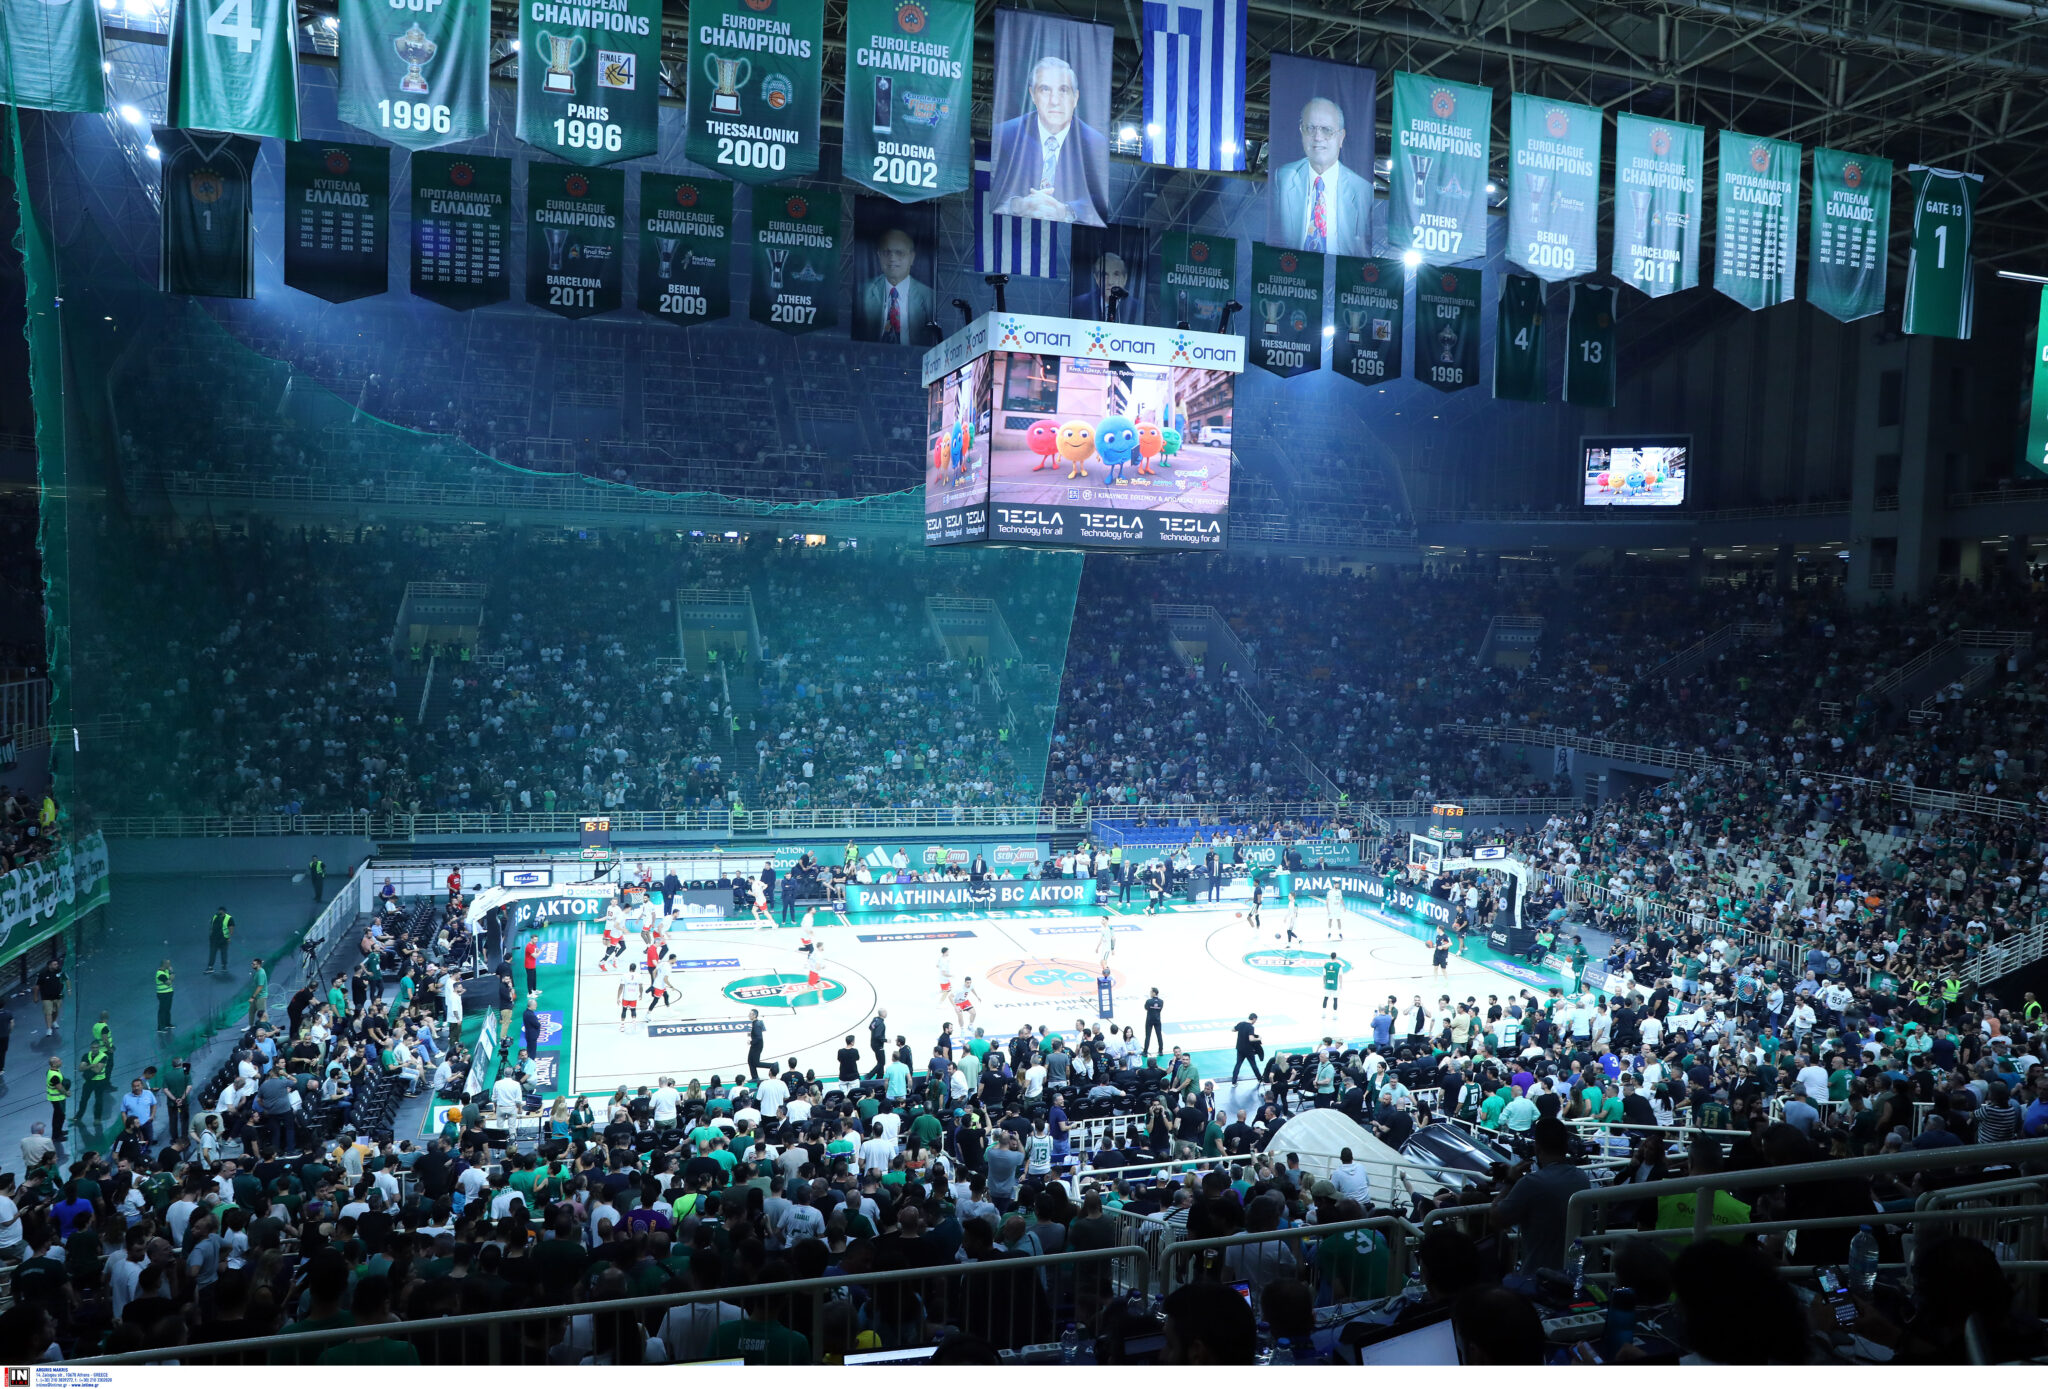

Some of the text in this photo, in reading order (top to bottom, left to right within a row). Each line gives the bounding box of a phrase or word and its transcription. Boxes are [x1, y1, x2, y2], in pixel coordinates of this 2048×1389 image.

[206, 0, 261, 53] 4
[531, 2, 650, 36] CHAMPIONS
[722, 13, 791, 36] EUROPEAN
[700, 25, 811, 58] CHAMPIONS
[871, 35, 949, 59] EUROLEAGUE
[857, 48, 962, 79] CHAMPIONS
[378, 99, 451, 134] 1996
[567, 103, 609, 121] PARIS
[553, 118, 622, 152] 1996
[706, 120, 799, 144] THESSALONIKI
[1411, 118, 1472, 140] EUROLEAGUE
[877, 141, 936, 161] BOLOGNA
[1400, 130, 1482, 159] CHAMPIONS
[1527, 138, 1584, 159] EUROLEAGUE
[716, 138, 786, 171] 2000
[1517, 150, 1593, 176] CHAMPIONS
[872, 156, 938, 188] 2002
[1632, 156, 1686, 176] EUROLEAGUE
[314, 179, 361, 193] ΚΥΠΕΛΛΑ
[1622, 167, 1695, 193] CHAMPIONS
[1725, 173, 1792, 194] ΠΡΩΤΑΘΛΗΜΑΤΑ
[305, 189, 369, 207] ΕΛΛΑΔΟΣ
[420, 188, 502, 204] ΠΡΩΤΑΘΛΗΜΑΤΑ
[1733, 185, 1783, 207] ΕΛΛΑΔΟΣ
[1833, 190, 1869, 207] ΚΥΠΕΛΛΑ
[430, 200, 492, 217] ΕΛΛΑΔΟΣ
[546, 199, 606, 213] EUROLEAGUE
[1826, 201, 1874, 222] ΕΛΛΑΔΟΣ
[1926, 200, 1962, 217] GATE 13
[202, 210, 212, 231] 1
[535, 209, 616, 228] CHAMPIONS
[657, 209, 715, 223] EUROLEAGUE
[1419, 213, 1458, 229] ATHENS
[647, 218, 724, 238] CHAMPIONS
[768, 221, 824, 235] EUROLEAGUE
[1537, 230, 1568, 245] BERLIN
[759, 230, 833, 249] CHAMPIONS
[1412, 226, 1463, 254] 2007
[1935, 225, 1947, 269] 1
[1528, 243, 1575, 270] 2009
[1631, 244, 1680, 262] BARCELONA
[1175, 263, 1222, 278] EUROLEAGUE
[1633, 258, 1675, 284] 2011
[546, 275, 602, 289] BARCELONA
[668, 283, 700, 296] BERLIN
[1167, 272, 1230, 290] CHAMPIONS
[1269, 275, 1306, 287] EUROPEAN
[550, 286, 594, 308] 2011
[777, 293, 812, 305] ATHENS
[1257, 283, 1318, 300] CHAMPIONS
[1352, 285, 1388, 297] EUROPEAN
[659, 294, 707, 315] 2009
[1340, 292, 1399, 310] CHAMPIONS
[770, 304, 816, 324] 2007
[1436, 305, 1460, 320] CUP
[1260, 338, 1311, 352] THESSALONIKI
[1514, 327, 1529, 351] 4
[1266, 350, 1304, 368] 2000
[1357, 349, 1378, 359] PARIS
[1580, 339, 1602, 364] 13
[1351, 358, 1385, 377] 1996
[1431, 365, 1463, 384] 1996
[997, 509, 1064, 525] TESLA
[1080, 513, 1144, 529] TESLA
[1159, 517, 1221, 533] TESLA
[998, 525, 1063, 537] Technology for all
[1080, 528, 1143, 540] Technology for all
[1160, 532, 1220, 544] Technology for all
[776, 847, 805, 855] ALTION
[1307, 845, 1350, 855] TESLA
[1001, 885, 1084, 901] BC AKTOR
[536, 898, 599, 917] AKTOR
[1400, 893, 1449, 924] BC AKTOR
[706, 958, 738, 968] PAY
[1035, 1148, 1048, 1160] 13
